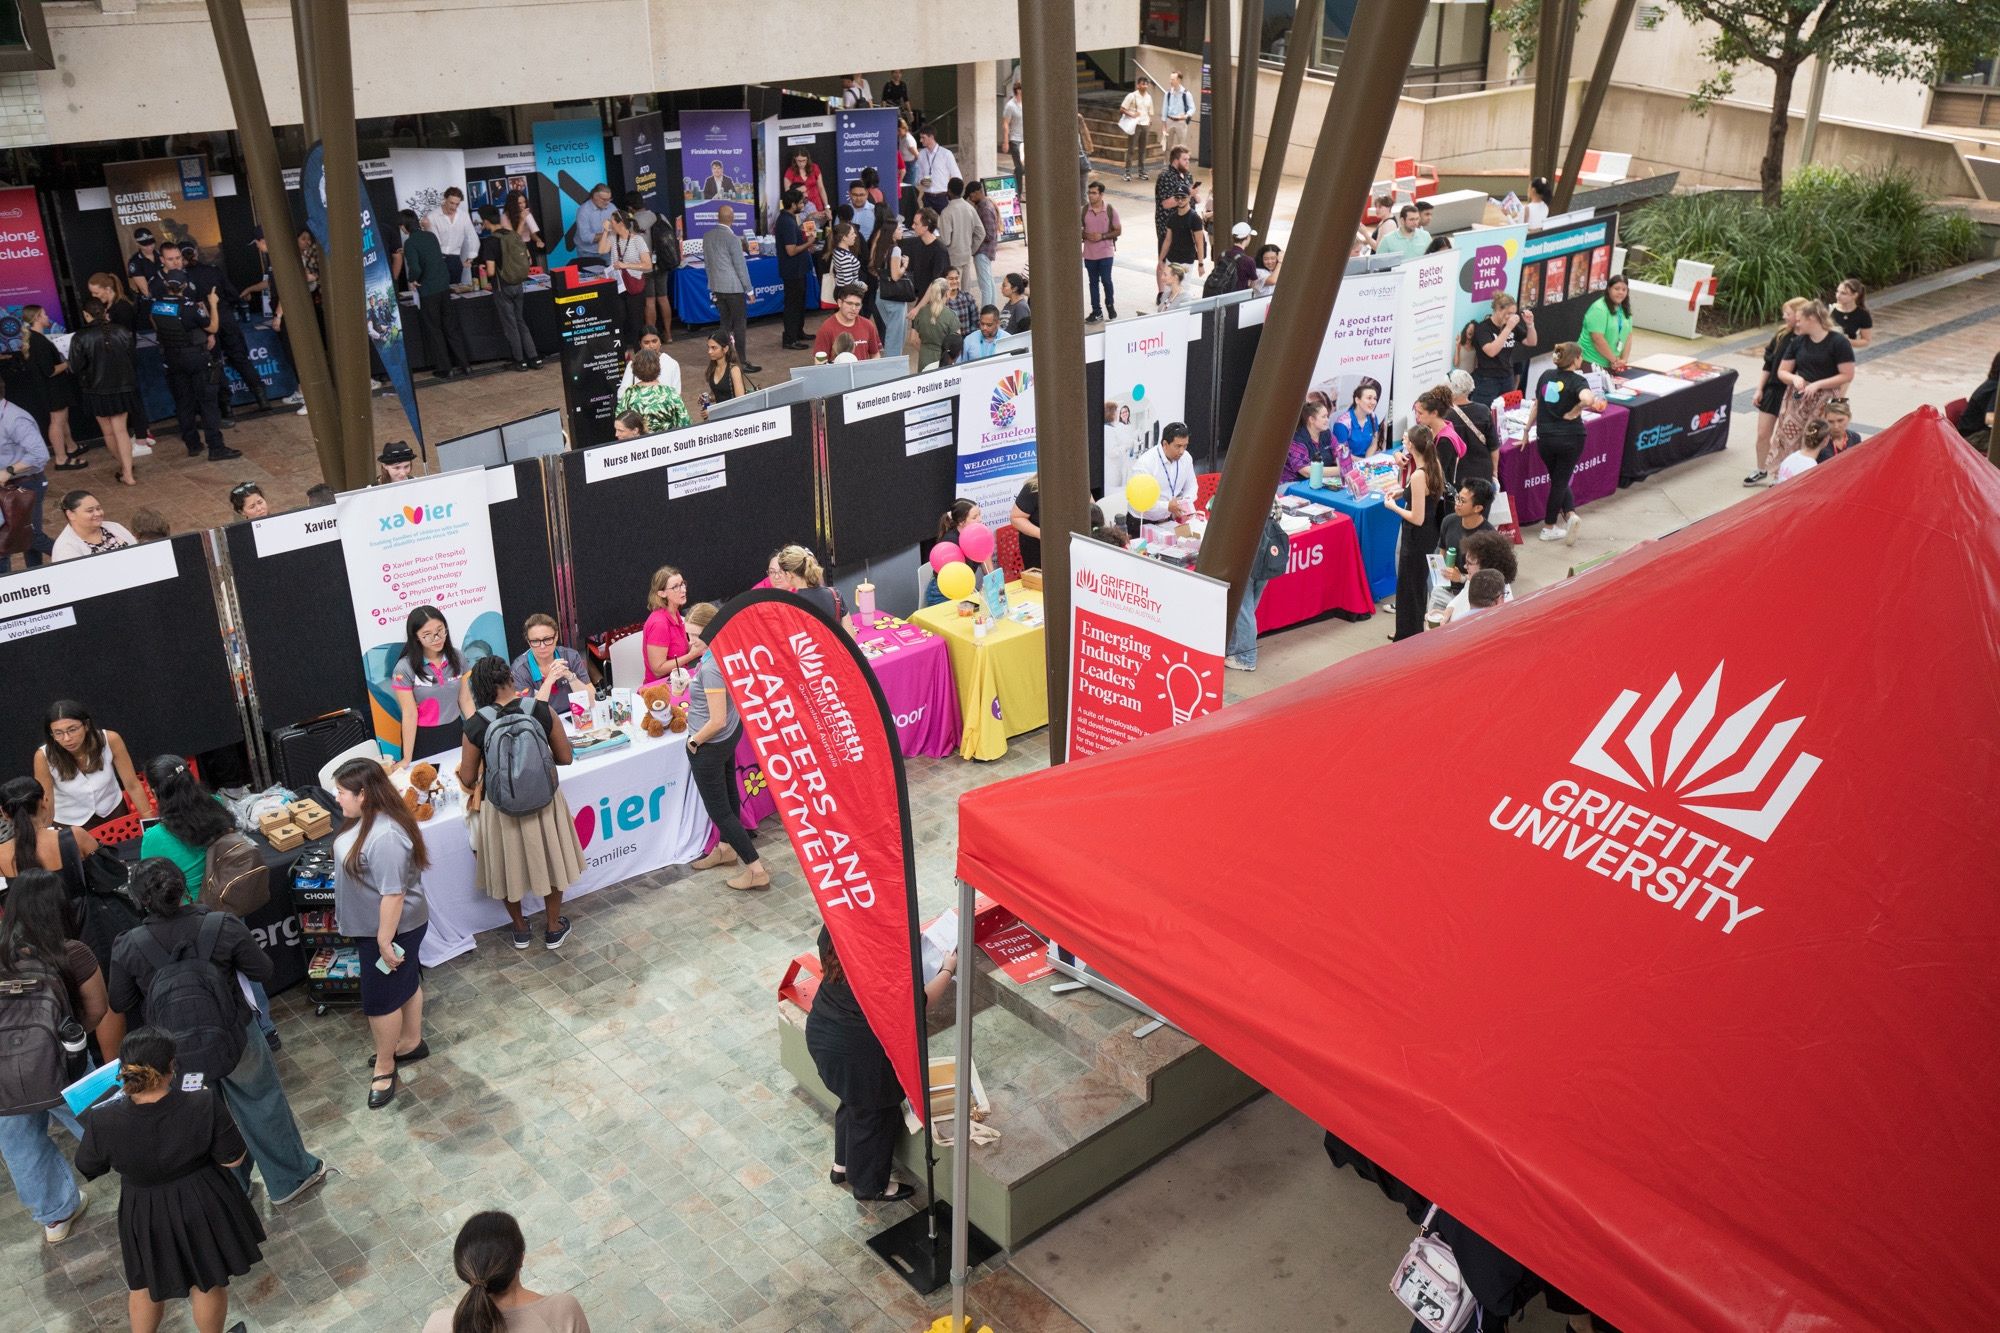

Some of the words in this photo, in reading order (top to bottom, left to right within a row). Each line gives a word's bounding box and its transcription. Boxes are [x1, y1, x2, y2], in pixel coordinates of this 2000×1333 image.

[843, 131, 880, 140] Queensland
[843, 140, 860, 148] Audit
[861, 139, 880, 147] Office
[497, 151, 518, 159] Services
[519, 150, 535, 158] Austra
[545, 141, 590, 153] Services
[547, 152, 596, 166] Australia
[640, 165, 650, 174] ATO
[114, 190, 171, 204] GATHERING.
[118, 212, 161, 226] TESTING.
[0, 246, 44, 260] clude.
[1478, 255, 1501, 267] JOIN
[1419, 265, 1443, 279] Better
[1479, 268, 1497, 278] THE
[755, 283, 784, 297] progra
[1418, 276, 1443, 288] Rehab
[1474, 278, 1500, 290] TEAM
[1339, 318, 1345, 327] A
[1347, 316, 1370, 328] good
[1372, 313, 1394, 323] start
[574, 327, 594, 335] ACADEMIC
[1334, 329, 1346, 339] for
[1356, 326, 1393, 337] brighter
[1139, 331, 1164, 354] qml
[1364, 337, 1392, 347] future
[1146, 349, 1171, 358] pathology
[1356, 354, 1369, 362] our
[1371, 352, 1390, 360] team
[857, 394, 890, 411] Kameleon
[891, 389, 912, 402] Group
[917, 380, 943, 394] Positive
[603, 454, 628, 468] Nurse
[630, 450, 650, 462] Next
[651, 445, 672, 457] Door,
[673, 438, 696, 452] South
[762, 419, 777, 431] Rim
[963, 456, 1005, 470] WELCOME
[1006, 452, 1018, 462] TO
[1018, 449, 1037, 459] CHA
[1524, 473, 1551, 489] REDEF
[1573, 453, 1607, 474] OSSIBLE
[674, 473, 720, 489] Disability-Inclusive
[684, 484, 711, 495] Workplace
[304, 519, 337, 534] Xavier
[392, 560, 413, 570] Xavier
[415, 555, 434, 564] Place
[434, 548, 466, 560] (Respite)
[1285, 542, 1324, 575] lius
[393, 565, 439, 580] Occupational
[440, 559, 468, 569] Therapy
[401, 577, 427, 589] Speech
[428, 570, 463, 582] Pathology
[1100, 574, 1149, 598] GRIFFITH
[0, 584, 51, 605] omberg
[409, 581, 458, 597] Physiotherapy
[382, 604, 404, 614] Music
[404, 597, 432, 609] Therapy
[446, 588, 459, 598] Art
[459, 584, 487, 595] Therapy
[459, 595, 485, 606] Worker
[1100, 584, 1162, 614] UNIVERSITY
[1099, 598, 1135, 614] QUEENSLAND
[1135, 608, 1162, 624] AUSTRALIA
[0, 610, 64, 631] sability-Inclusive
[8, 624, 51, 639] Workplace
[1081, 620, 1152, 660] Emerging
[1081, 640, 1143, 676] Industry
[1080, 659, 1136, 690] Leaders
[1079, 678, 1142, 713] Program
[809, 679, 854, 763] UNIVERSITY
[821, 675, 865, 762] Griffith
[892, 706, 925, 728] oor
[1083, 709, 1097, 719] suite
[1105, 717, 1144, 737] employability
[799, 683, 822, 731] Queensland
[819, 732, 838, 768] Australia
[1076, 725, 1099, 740] industry
[1077, 716, 1087, 724] skill
[1088, 721, 1126, 738] development
[1076, 734, 1084, 743] for
[1084, 738, 1095, 746] the
[722, 648, 854, 911] EMPLOYMENT
[749, 644, 838, 817] CAREERS
[825, 828, 876, 910] AND
[1542, 779, 1755, 890] GRIFFITH
[1488, 795, 1765, 935] UNIVERSITY
[985, 933, 1031, 949] Campus
[998, 942, 1032, 956] Tours
[1009, 951, 1039, 964] Here
